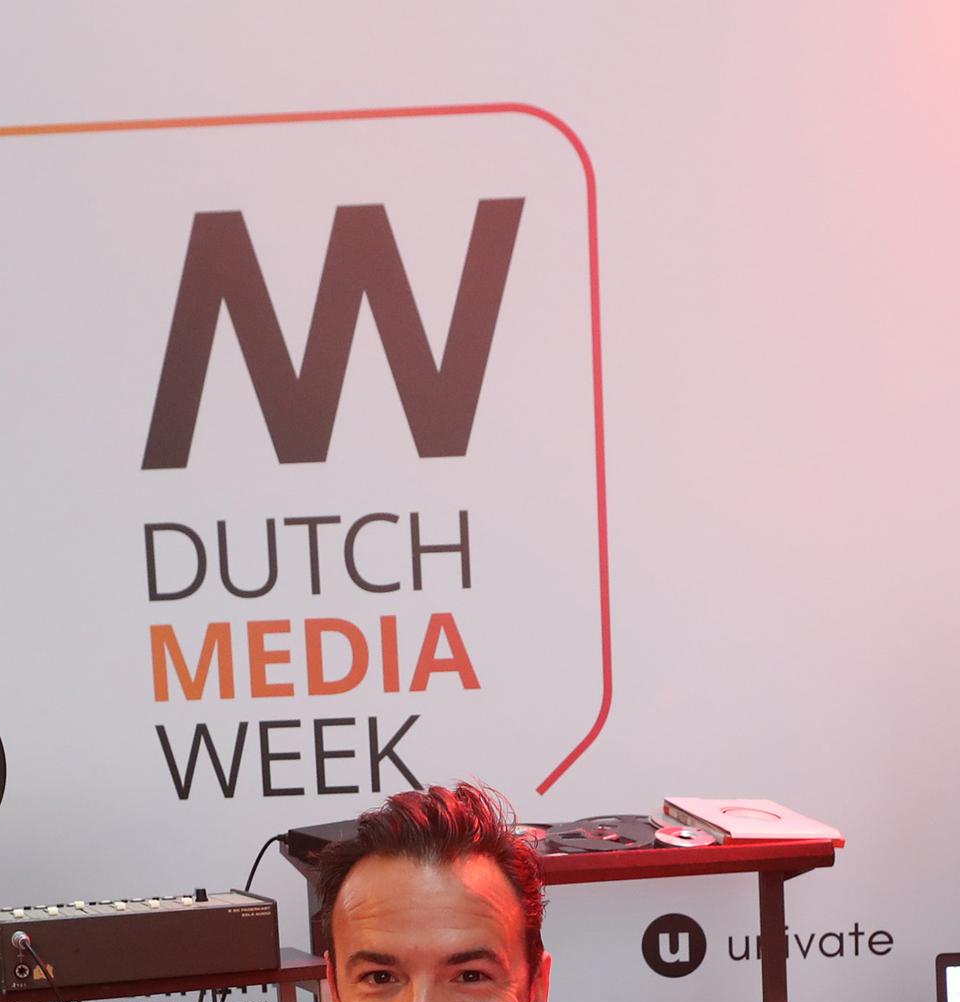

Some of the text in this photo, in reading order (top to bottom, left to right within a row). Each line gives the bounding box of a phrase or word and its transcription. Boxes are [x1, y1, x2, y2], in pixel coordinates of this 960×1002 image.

[144, 510, 472, 602] DUTCH
[149, 611, 481, 702] MEDIA
[155, 714, 425, 800] WEEK
[728, 922, 895, 961] uivate
